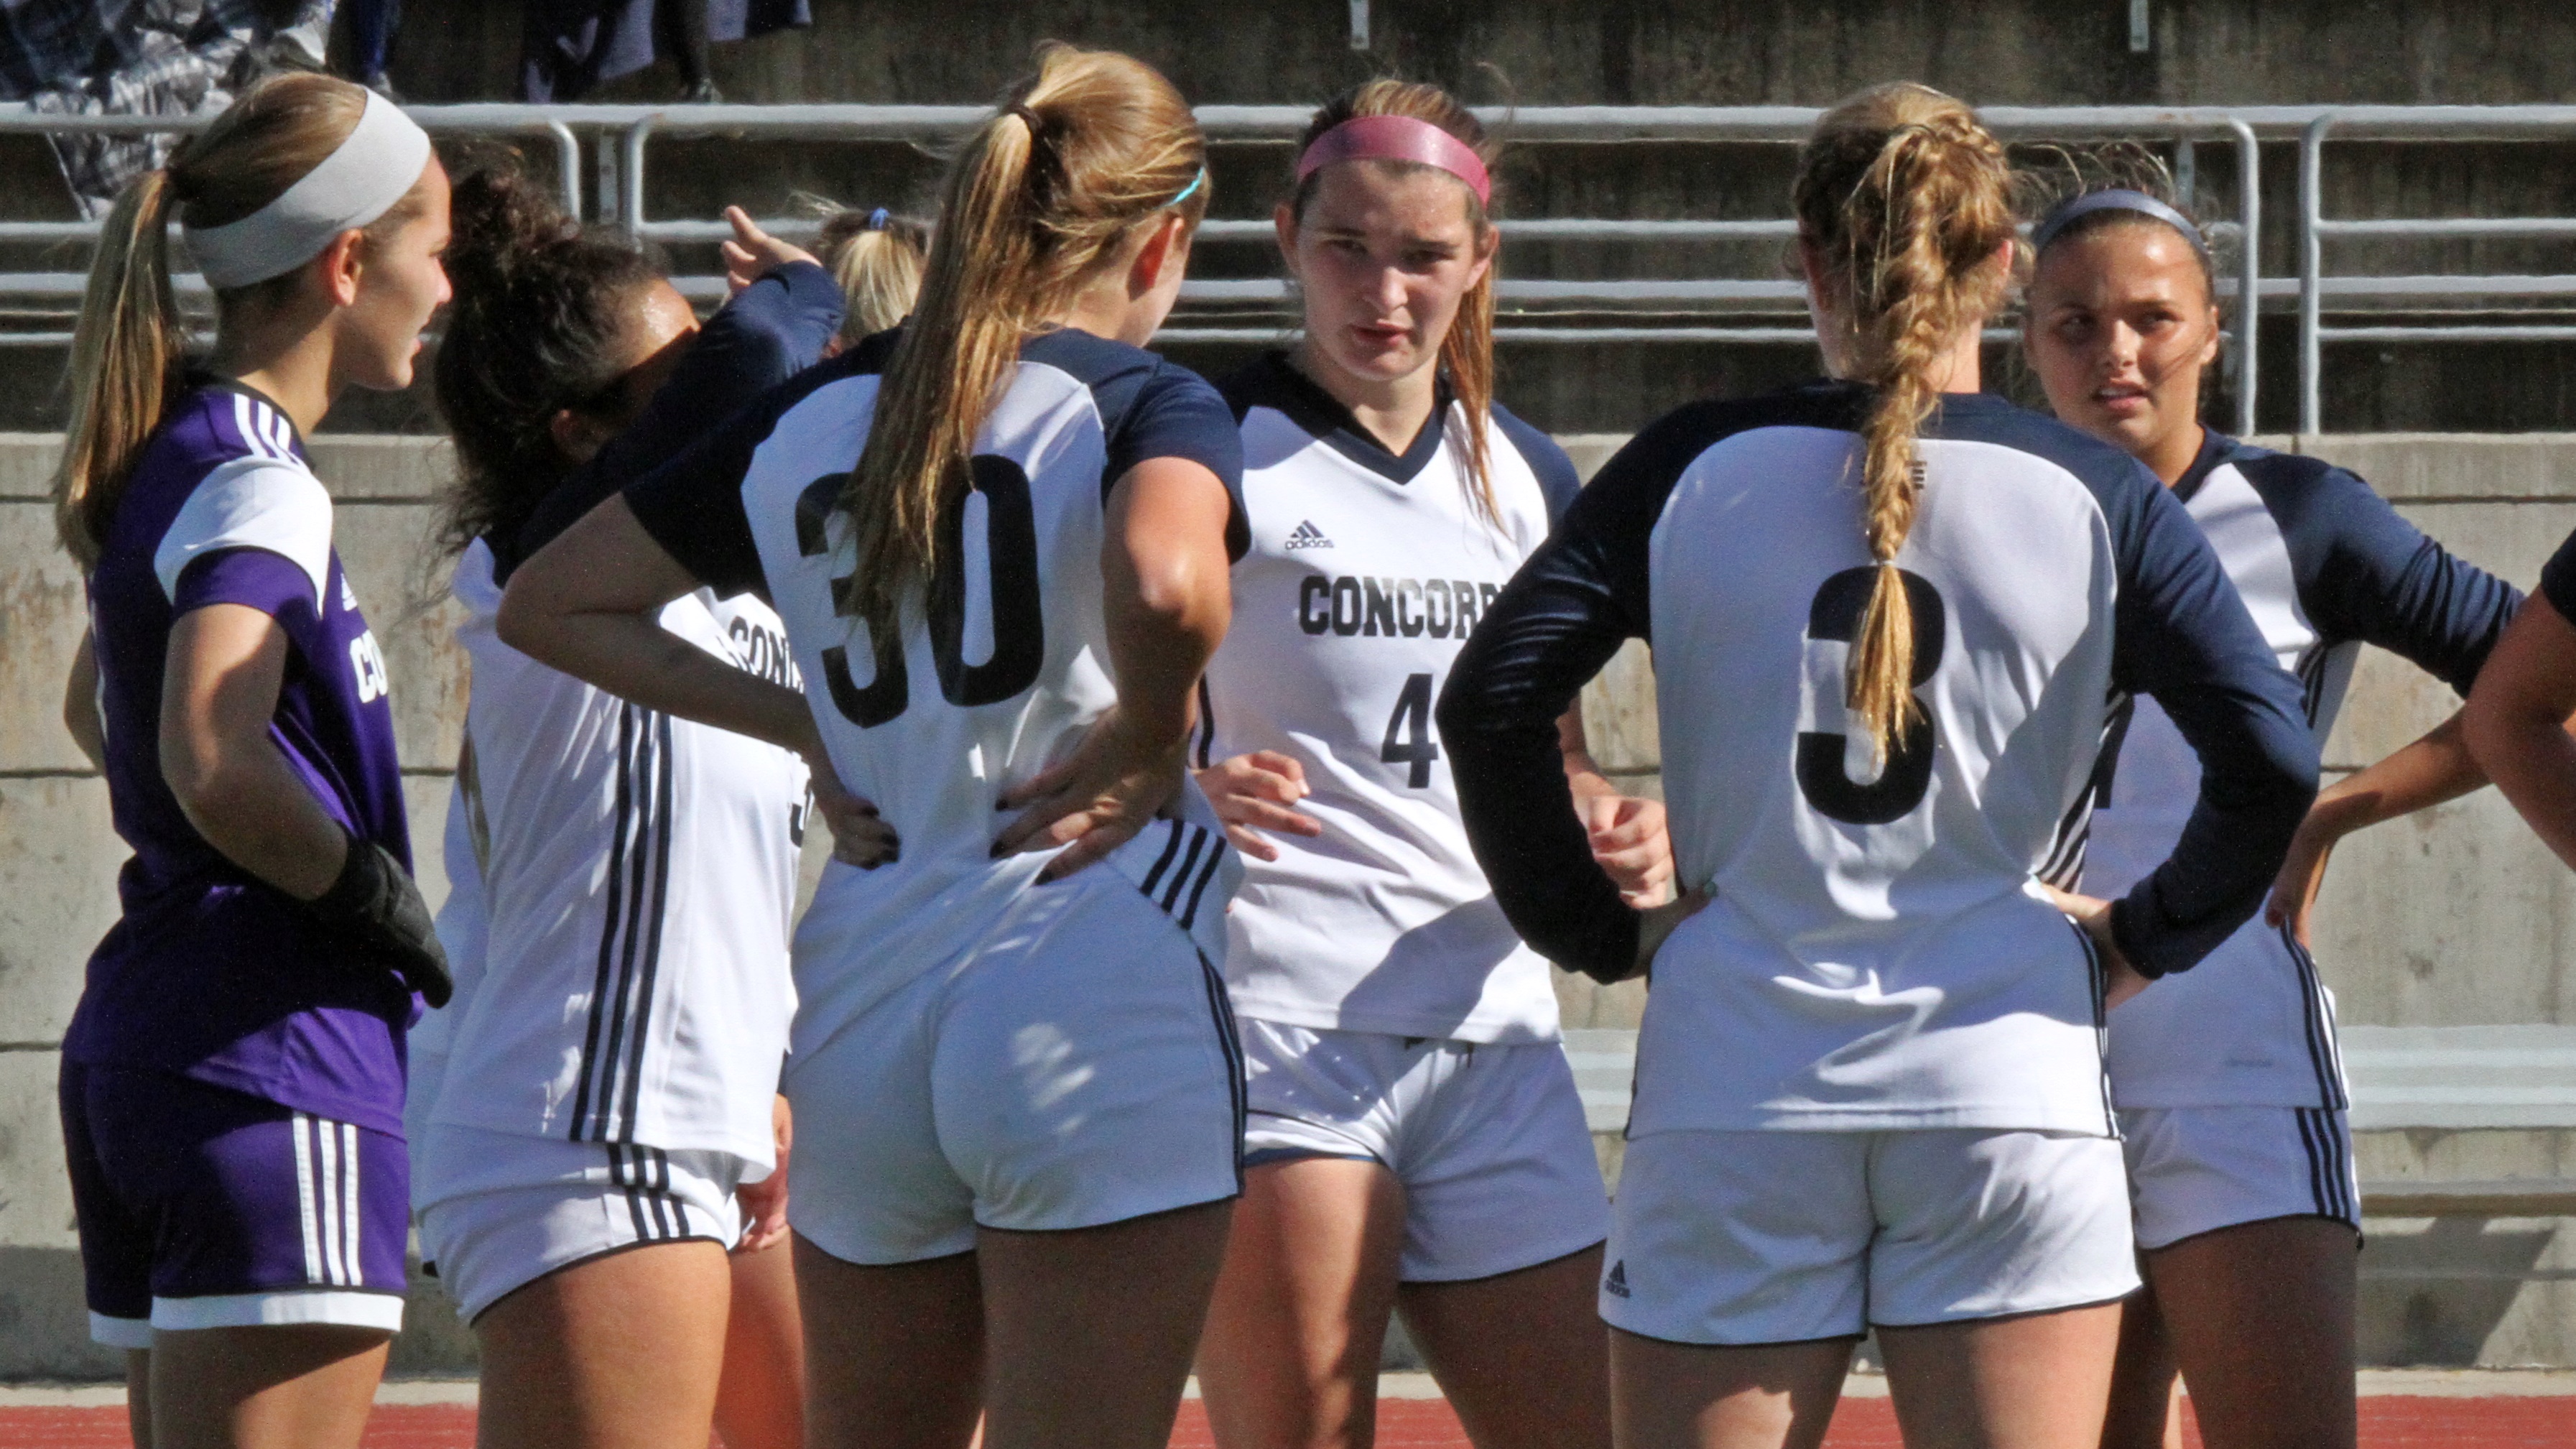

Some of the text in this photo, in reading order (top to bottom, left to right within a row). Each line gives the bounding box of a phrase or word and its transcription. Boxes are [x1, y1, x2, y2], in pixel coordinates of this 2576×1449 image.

[794, 454, 1044, 729] 30
[1284, 538, 1335, 551] adidas
[1381, 673, 1438, 788] 4
[1796, 565, 1946, 825] 3
